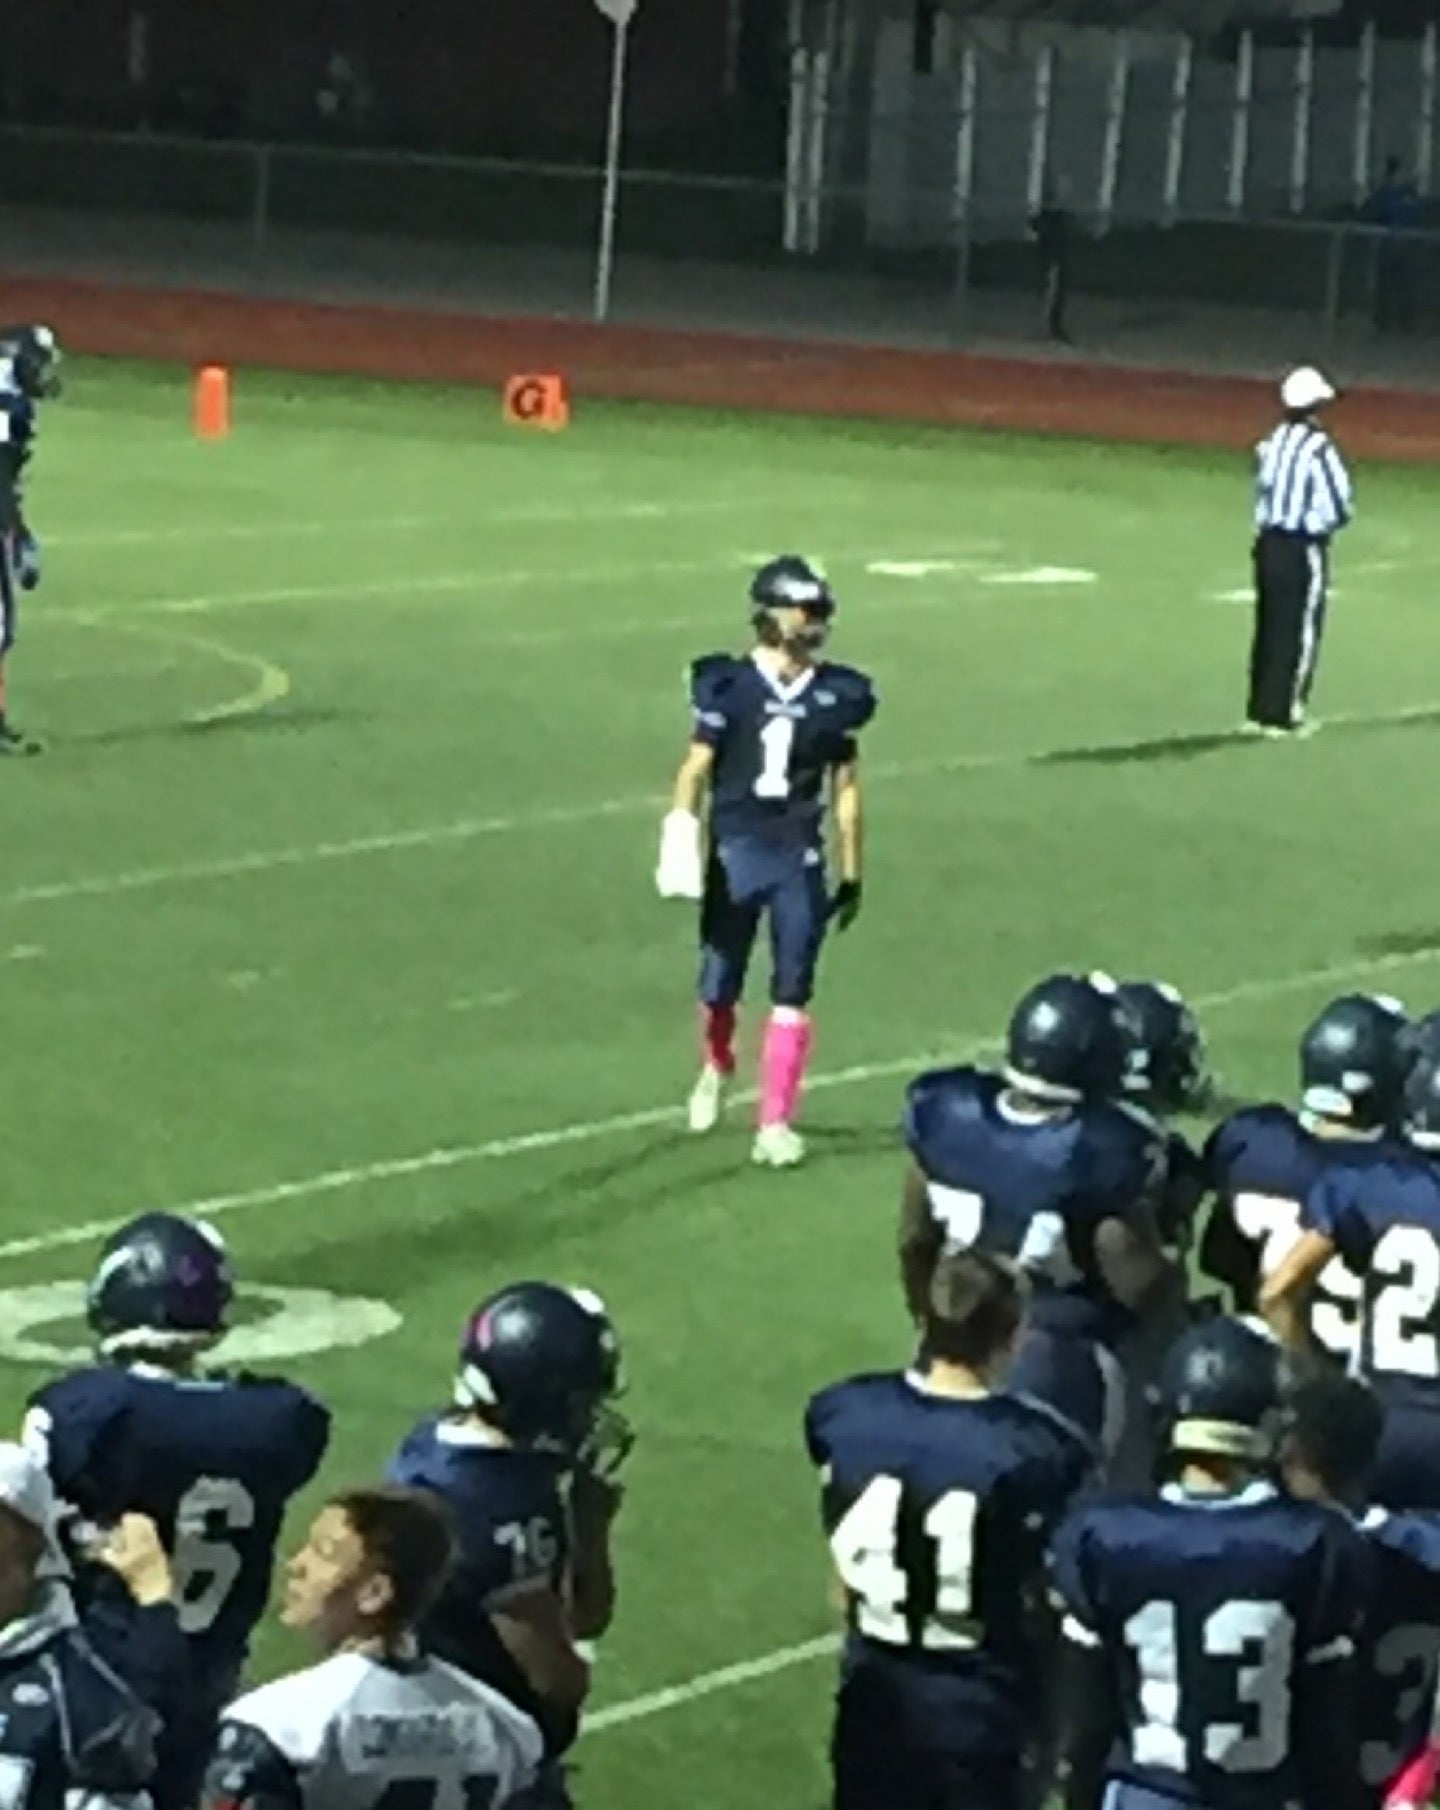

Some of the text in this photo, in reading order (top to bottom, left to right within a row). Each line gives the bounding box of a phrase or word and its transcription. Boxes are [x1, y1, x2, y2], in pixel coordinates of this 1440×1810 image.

[510, 380, 547, 420] G
[754, 716, 793, 797] 1
[174, 1474, 255, 1633] 6
[830, 1473, 985, 1650] 41
[1123, 1600, 1297, 1773] 13
